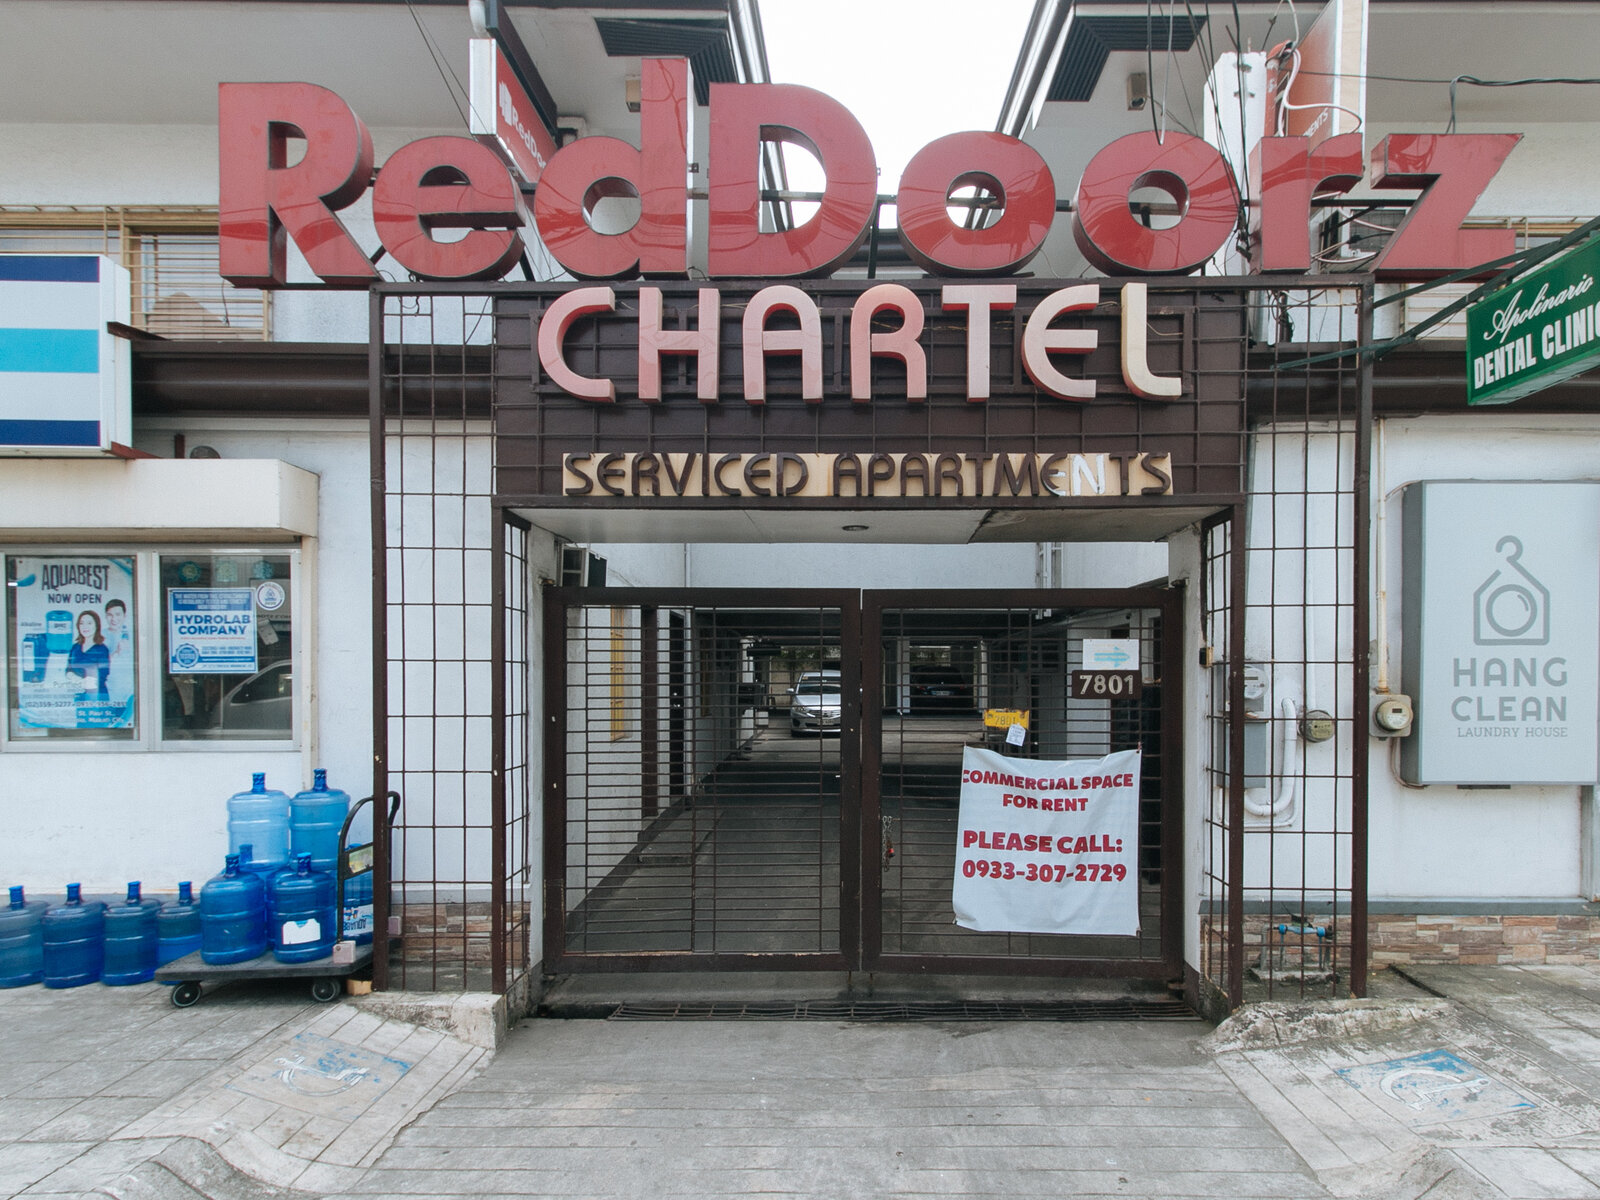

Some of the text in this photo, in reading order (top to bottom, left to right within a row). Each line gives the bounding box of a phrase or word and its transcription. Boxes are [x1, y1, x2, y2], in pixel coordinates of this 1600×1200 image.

[219, 56, 1523, 289] RedDoorz
[1483, 273, 1594, 345] Apolinario
[537, 282, 1182, 405] CHARTEL
[1473, 333, 1537, 390] DENTAL
[564, 451, 1172, 497] SERVICED APARTMENTS
[41, 564, 110, 592] AQUABEST
[48, 593, 103, 604] NOW OPEN
[174, 614, 251, 625] HYDROLAB
[178, 625, 248, 636] COMPANY
[1079, 674, 1134, 695] 7801
[1453, 657, 1568, 687] HANG
[1451, 696, 1567, 721] CLEAN
[1457, 727, 1568, 738] LAUNDRY HOUSE
[963, 769, 1134, 790] COMMERCIAL SPACE
[1002, 793, 1089, 812] FOR RENT
[963, 830, 1123, 855] PLEASE CALL:
[962, 859, 1127, 883] 0933-307-2729
